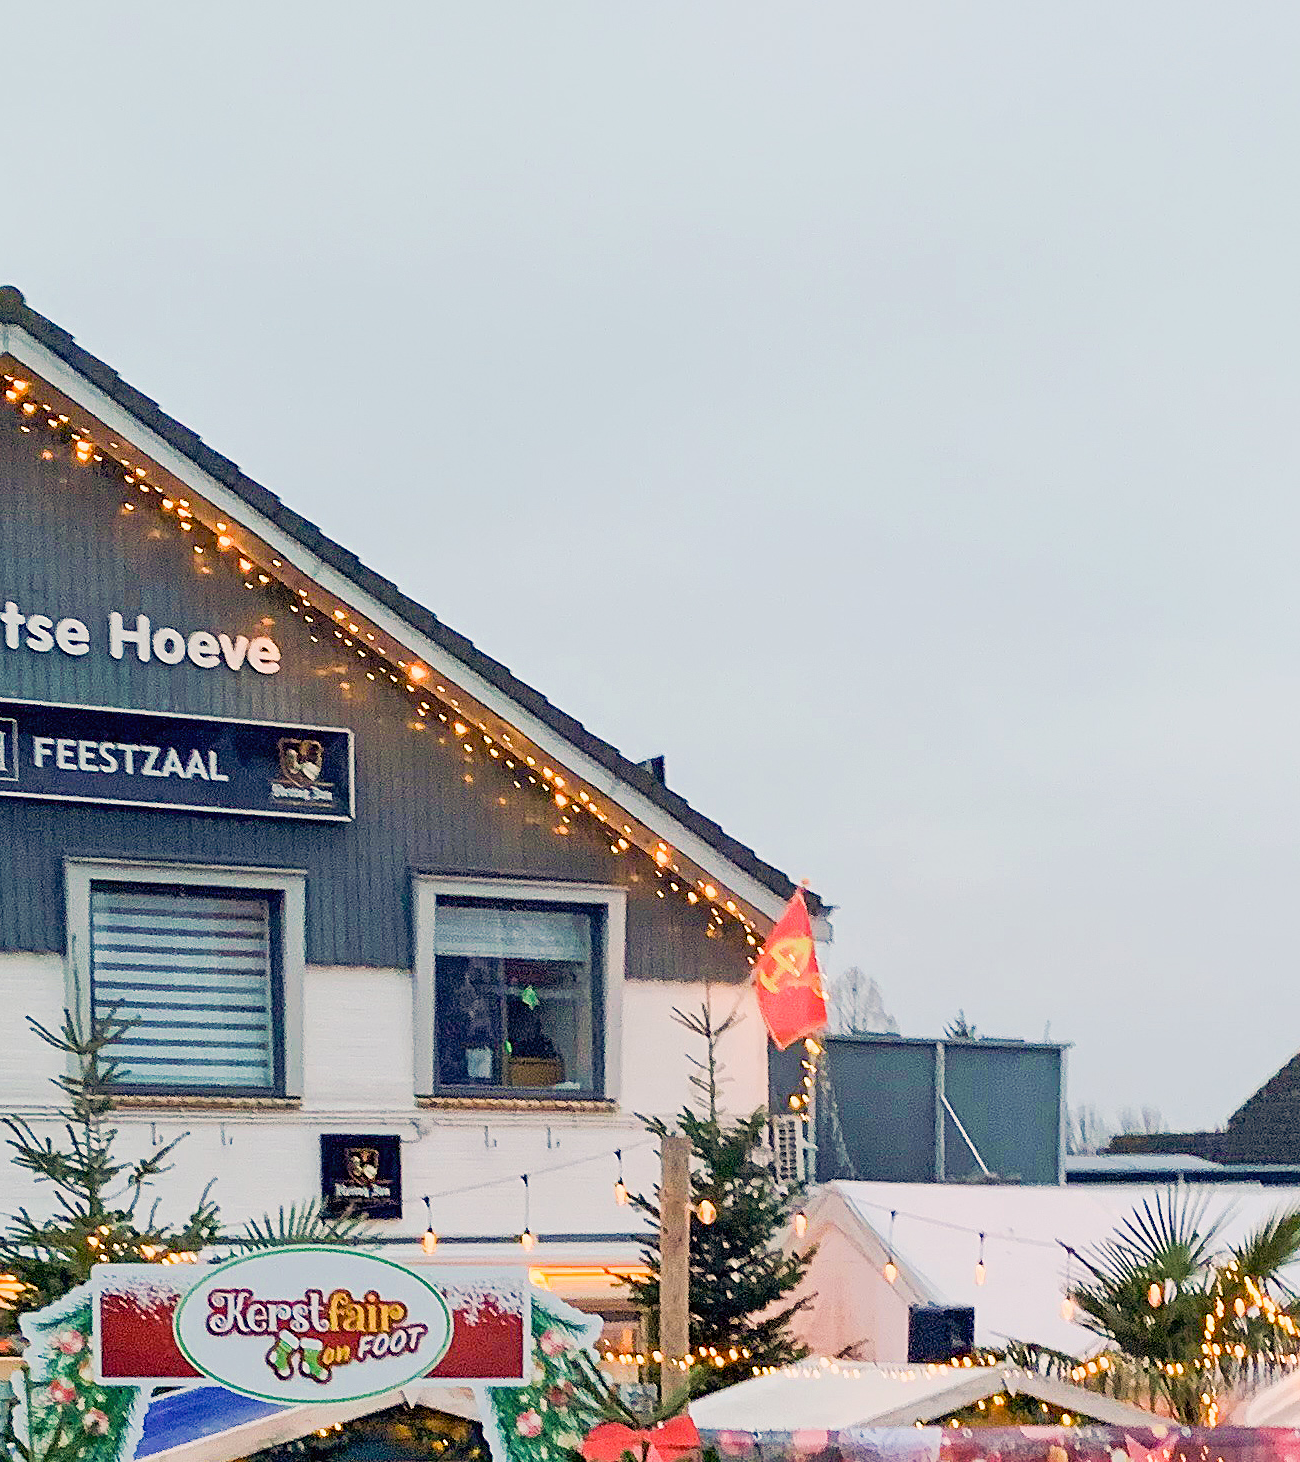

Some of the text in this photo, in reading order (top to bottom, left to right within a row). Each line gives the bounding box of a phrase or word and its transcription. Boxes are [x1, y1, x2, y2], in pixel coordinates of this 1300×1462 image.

[108, 612, 282, 675] Hoeve
[33, 735, 230, 783] FEESTZAAL
[206, 1288, 408, 1336] Kerstfair
[321, 1324, 429, 1366] on FOOT
